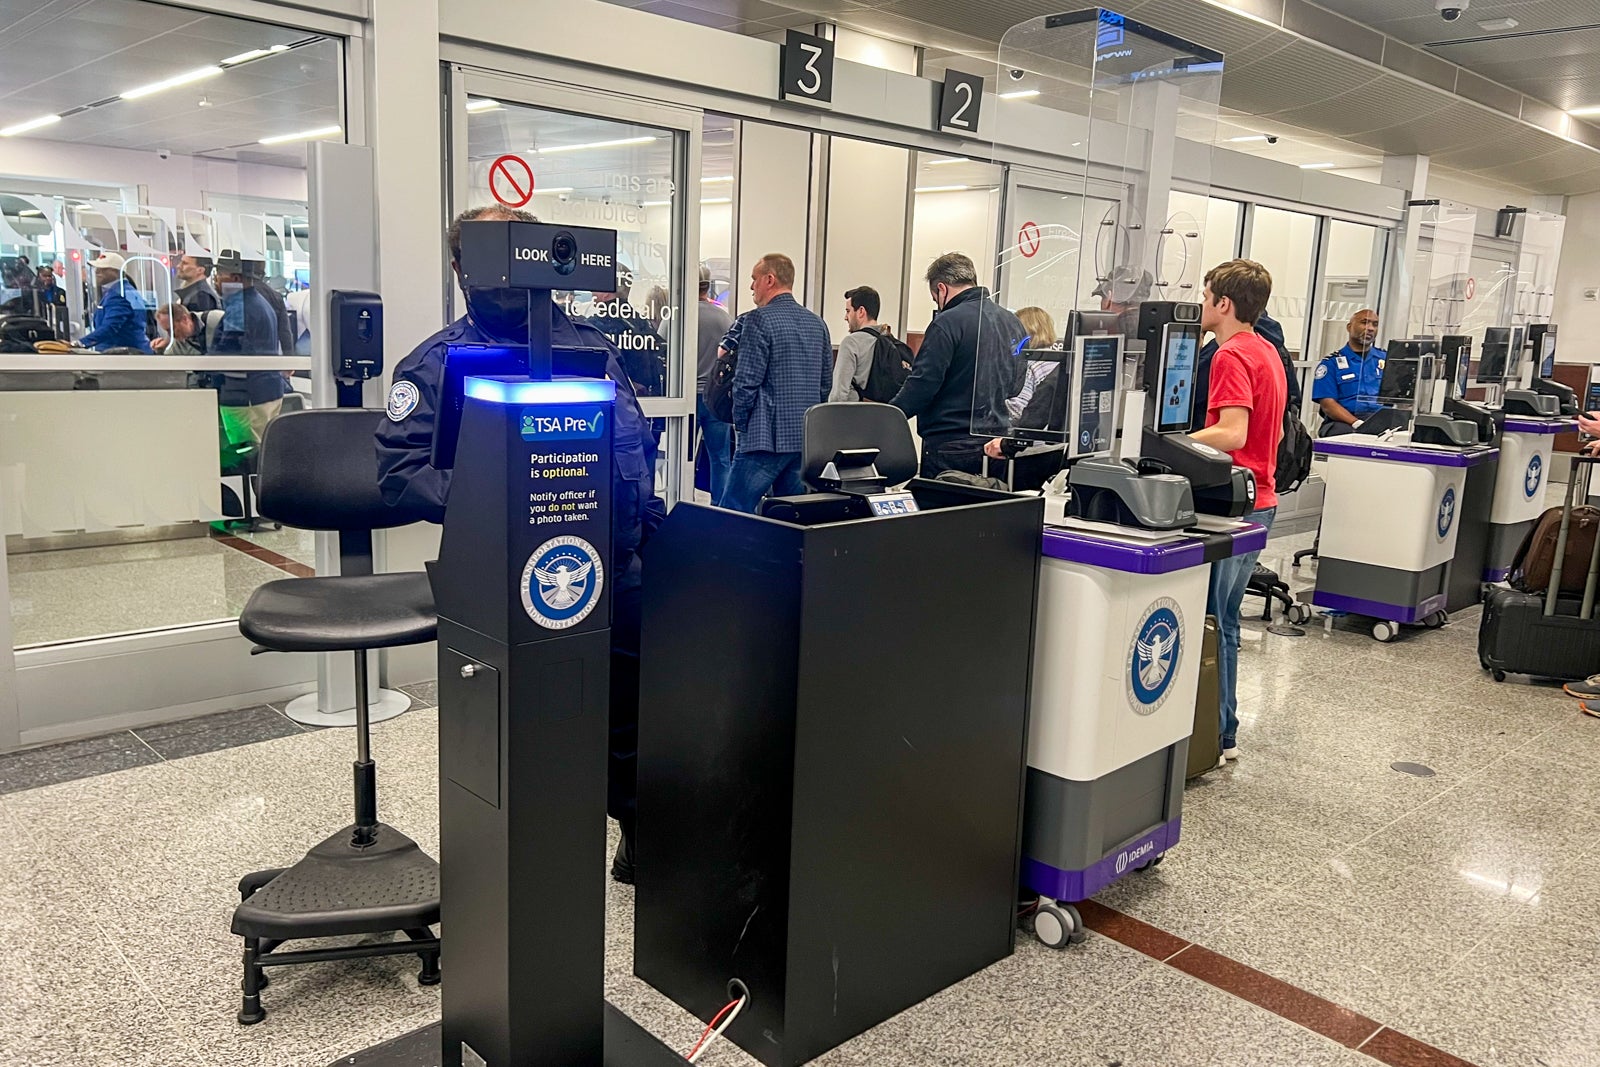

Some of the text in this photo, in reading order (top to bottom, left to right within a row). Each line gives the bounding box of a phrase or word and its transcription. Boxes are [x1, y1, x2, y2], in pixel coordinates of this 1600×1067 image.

[797, 43, 823, 95] 3
[950, 82, 973, 127] 2
[515, 247, 612, 267] LOOK HERE
[591, 296, 655, 320] federal
[660, 305, 679, 321] or
[535, 416, 587, 432] TSA Pre
[530, 452, 599, 465] Participation
[530, 466, 589, 479] is optional.
[530, 489, 596, 502] Notify officer if
[530, 501, 598, 515] you do not want
[529, 513, 589, 525] a photo taken.
[1128, 840, 1154, 863] IDEMIA
